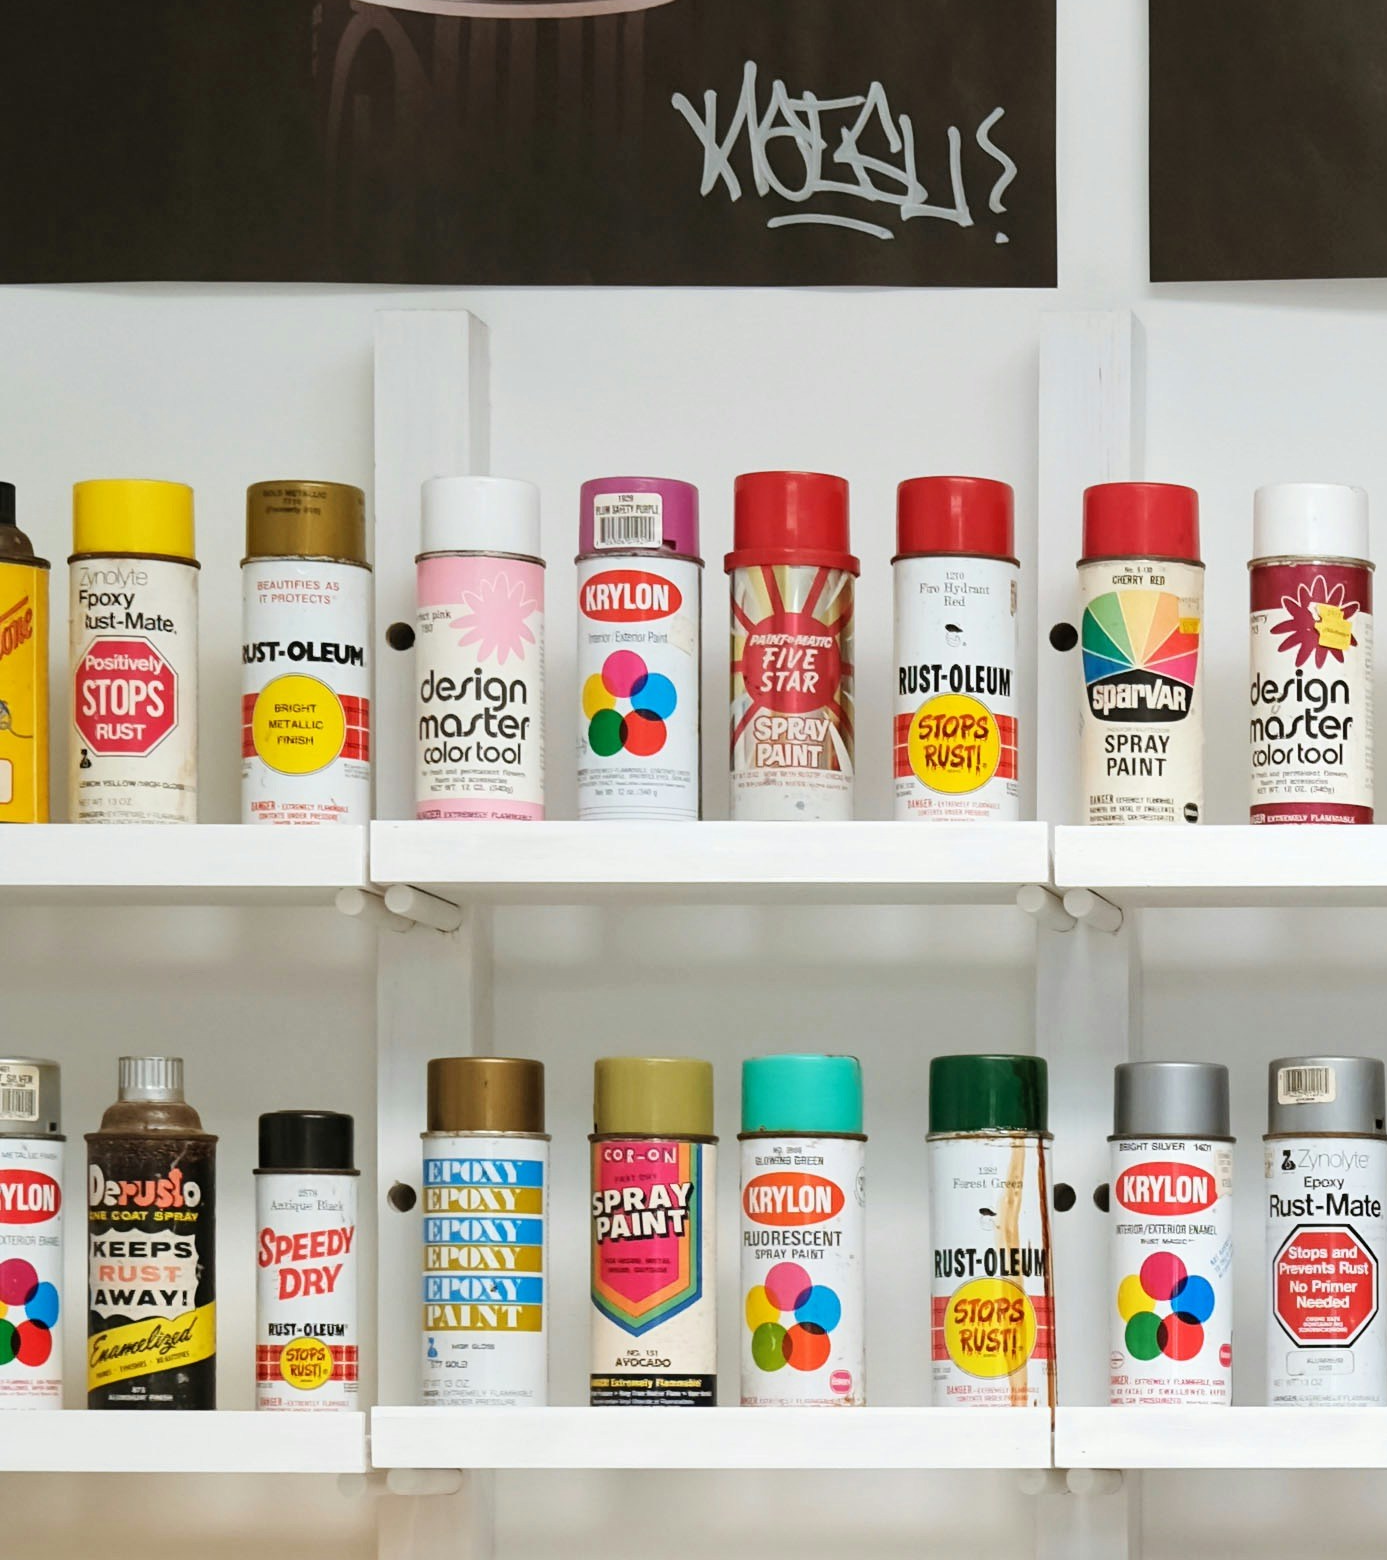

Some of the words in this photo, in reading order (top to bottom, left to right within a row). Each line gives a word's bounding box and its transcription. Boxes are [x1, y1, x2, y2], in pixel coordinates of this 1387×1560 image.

[256, 581, 321, 591] BEAUTIFIES
[1149, 575, 1166, 585] RED
[585, 583, 669, 612] KRYLON
[86, 654, 163, 674] Positively
[762, 648, 819, 669] FIVE
[421, 669, 528, 708] design
[761, 672, 817, 693] STAR
[899, 665, 1012, 696] RUST-OLEUM
[82, 680, 164, 718] STOPS
[274, 703, 316, 713] BRIGHT
[96, 724, 146, 740] RUST
[268, 719, 323, 730] METALLIC
[418, 711, 530, 740] master
[754, 718, 830, 741] SPRAY
[917, 713, 989, 743] STOPS
[278, 735, 314, 746] FINISH
[1104, 735, 1169, 755] SPRAY
[424, 741, 470, 765] color
[476, 741, 521, 765] tool
[756, 744, 821, 767] PAINT
[924, 745, 983, 776] RUST!
[1106, 757, 1166, 777] PAINT
[593, 1183, 691, 1215] SPRAY
[1123, 1175, 1207, 1203] KRYLON
[92, 1242, 191, 1258] KEEPS
[258, 1227, 354, 1267] SPEEDY
[1287, 1246, 1327, 1261] Stops
[1331, 1246, 1357, 1258] and
[98, 1266, 179, 1283] RUST
[1279, 1262, 1338, 1276] Prevents
[1341, 1262, 1368, 1274] Rust
[279, 1264, 342, 1300] DRY
[1291, 1281, 1309, 1293] No
[1313, 1280, 1357, 1293] Primer
[94, 1288, 188, 1308] AWAY!
[1296, 1296, 1349, 1309] Needed
[90, 1319, 193, 1365] Enamelized
